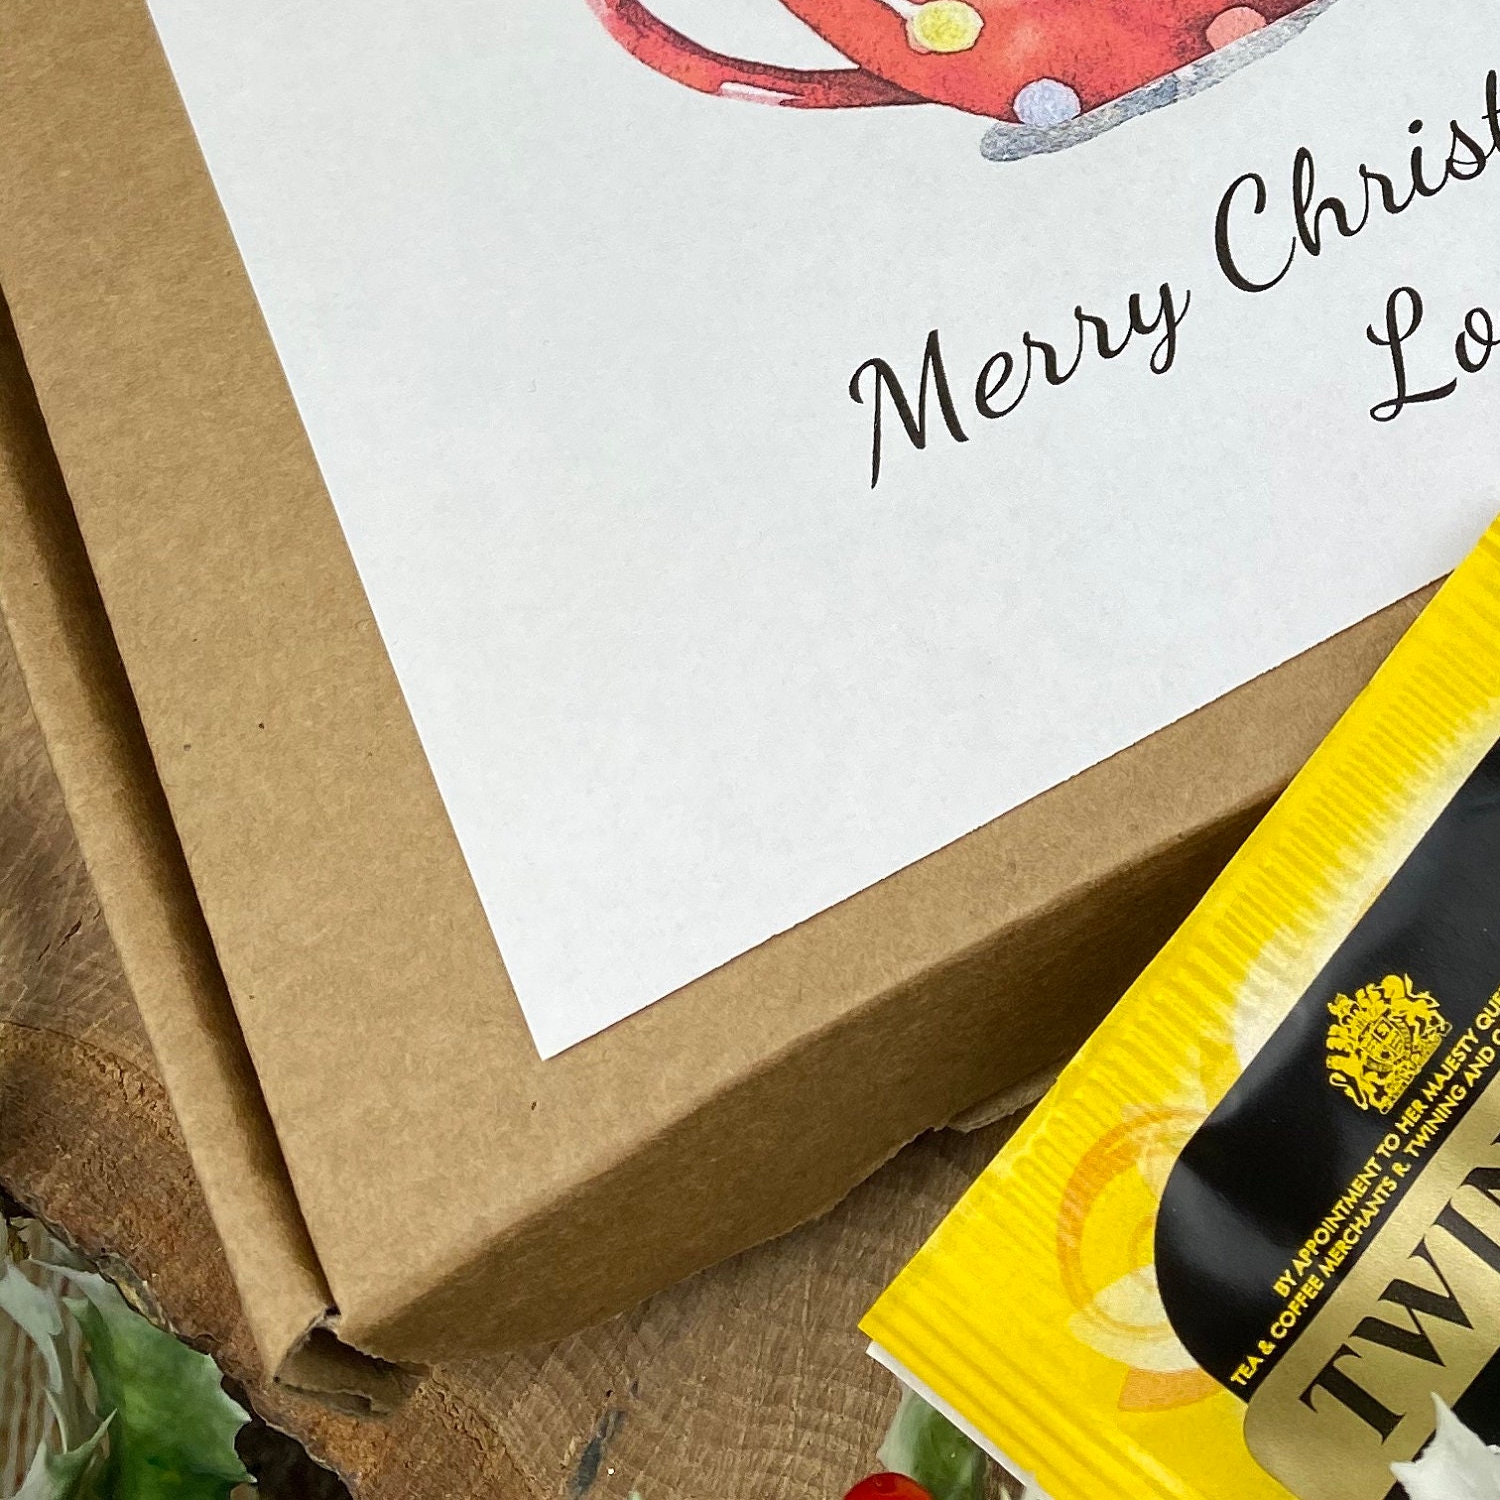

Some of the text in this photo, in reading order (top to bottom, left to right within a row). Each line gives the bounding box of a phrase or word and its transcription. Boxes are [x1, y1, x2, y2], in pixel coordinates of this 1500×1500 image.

[848, 281, 1191, 489] Merry
[1230, 1354, 1263, 1385] TEA
[1258, 1340, 1276, 1355] &
[1269, 1273, 1325, 1340] COFFEE
[1319, 1175, 1398, 1278] MERCHANTS
[1404, 1083, 1467, 1158] TWINING
[1464, 1045, 1495, 1088] AND
[1272, 1268, 1297, 1298] BY
[1292, 1156, 1382, 1277] APPOINTMENT
[1375, 1133, 1400, 1160] TO
[1395, 1099, 1428, 1134] HER
[1422, 1028, 1479, 1101] MAJESTY
